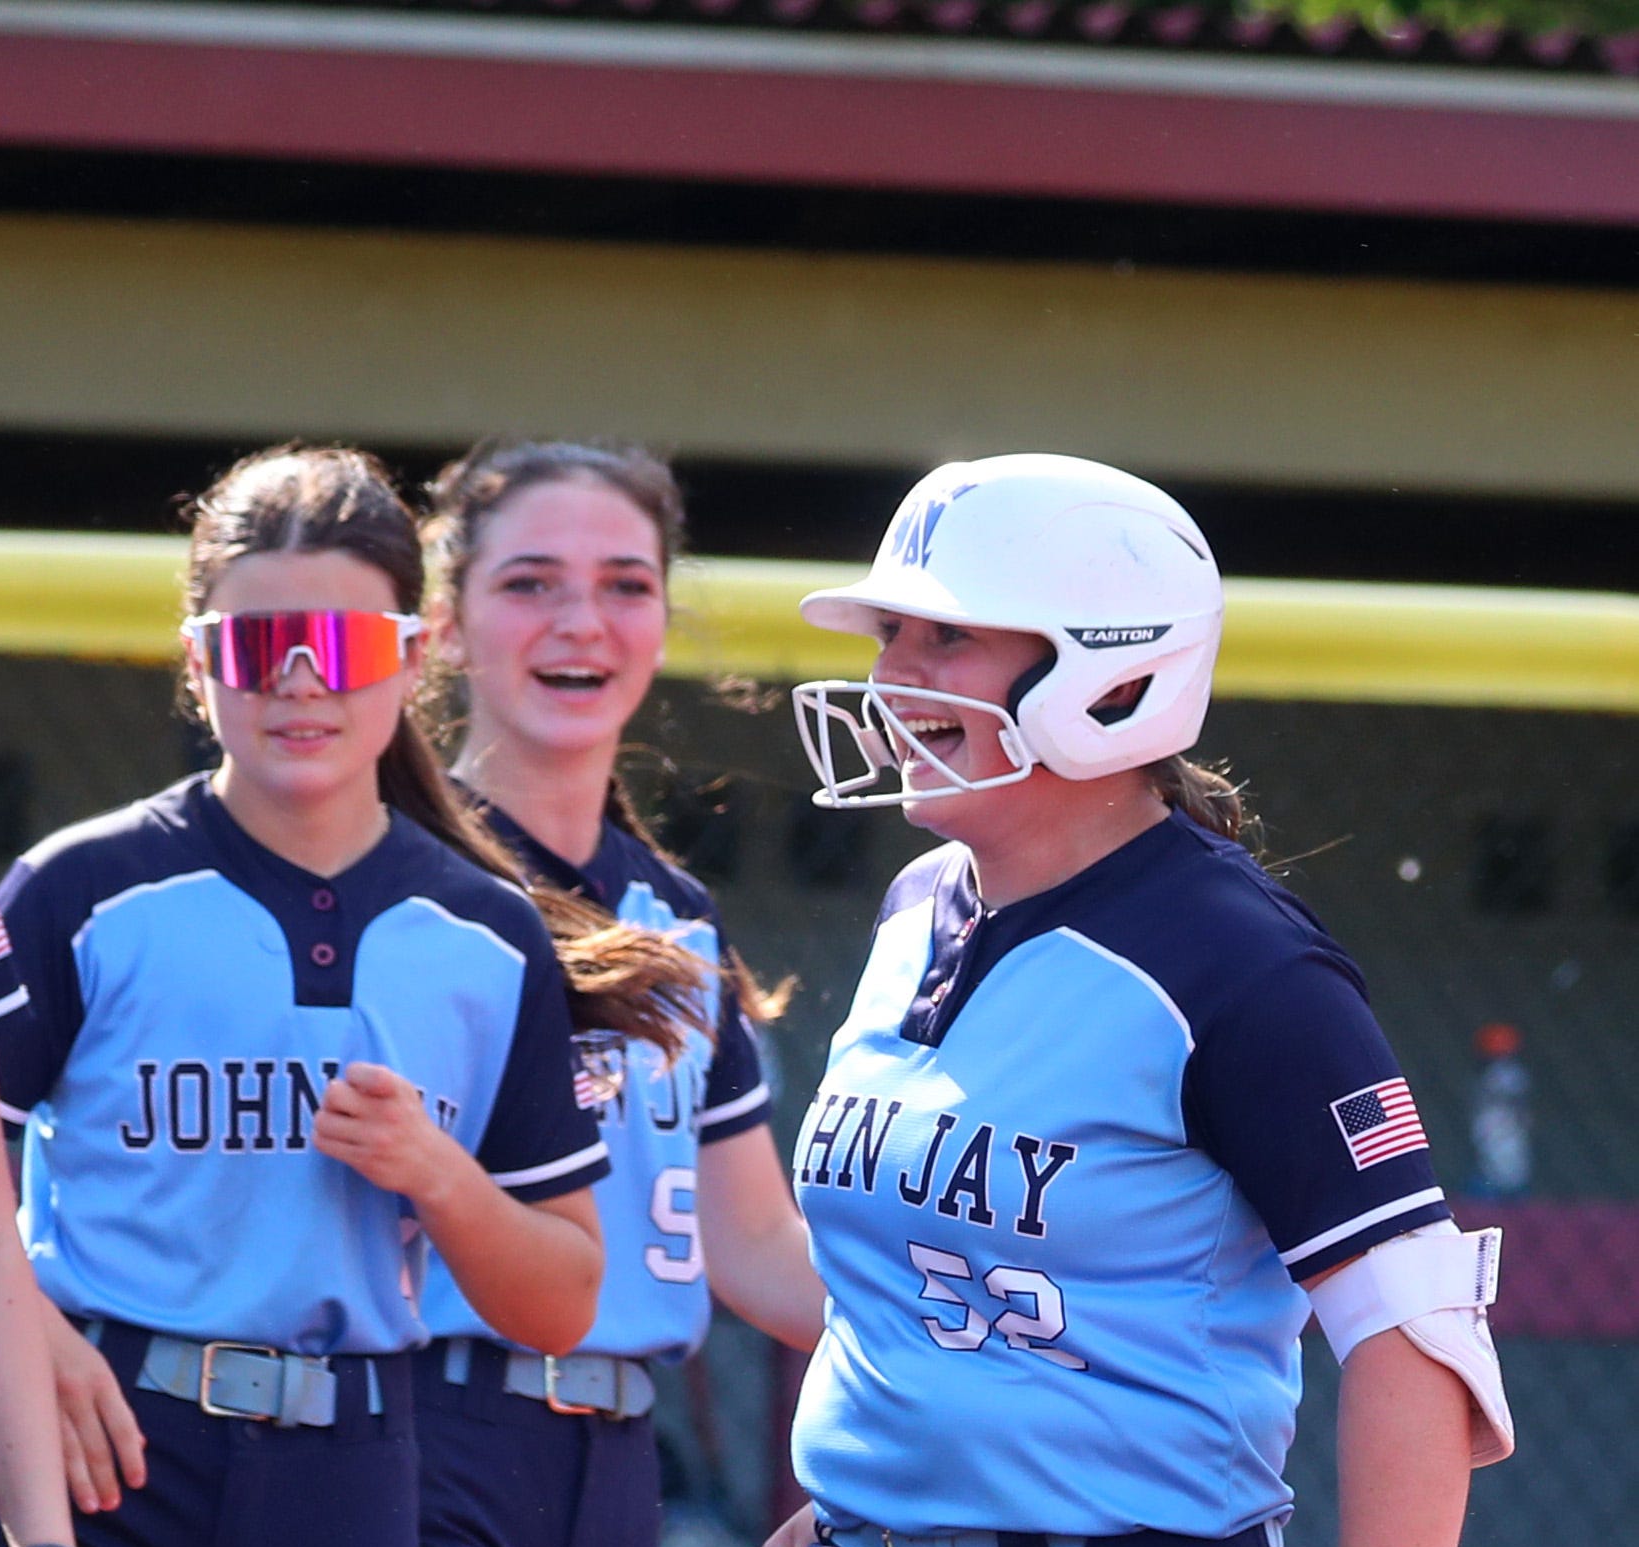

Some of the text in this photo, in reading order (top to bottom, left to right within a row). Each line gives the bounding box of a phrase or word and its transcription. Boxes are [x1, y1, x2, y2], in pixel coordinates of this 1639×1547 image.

[1081, 628, 1155, 643] EASTON
[118, 1058, 341, 1154] JOHN
[793, 1092, 903, 1194] HN
[897, 1112, 1079, 1240] JAY
[905, 1239, 1091, 1373] 52
